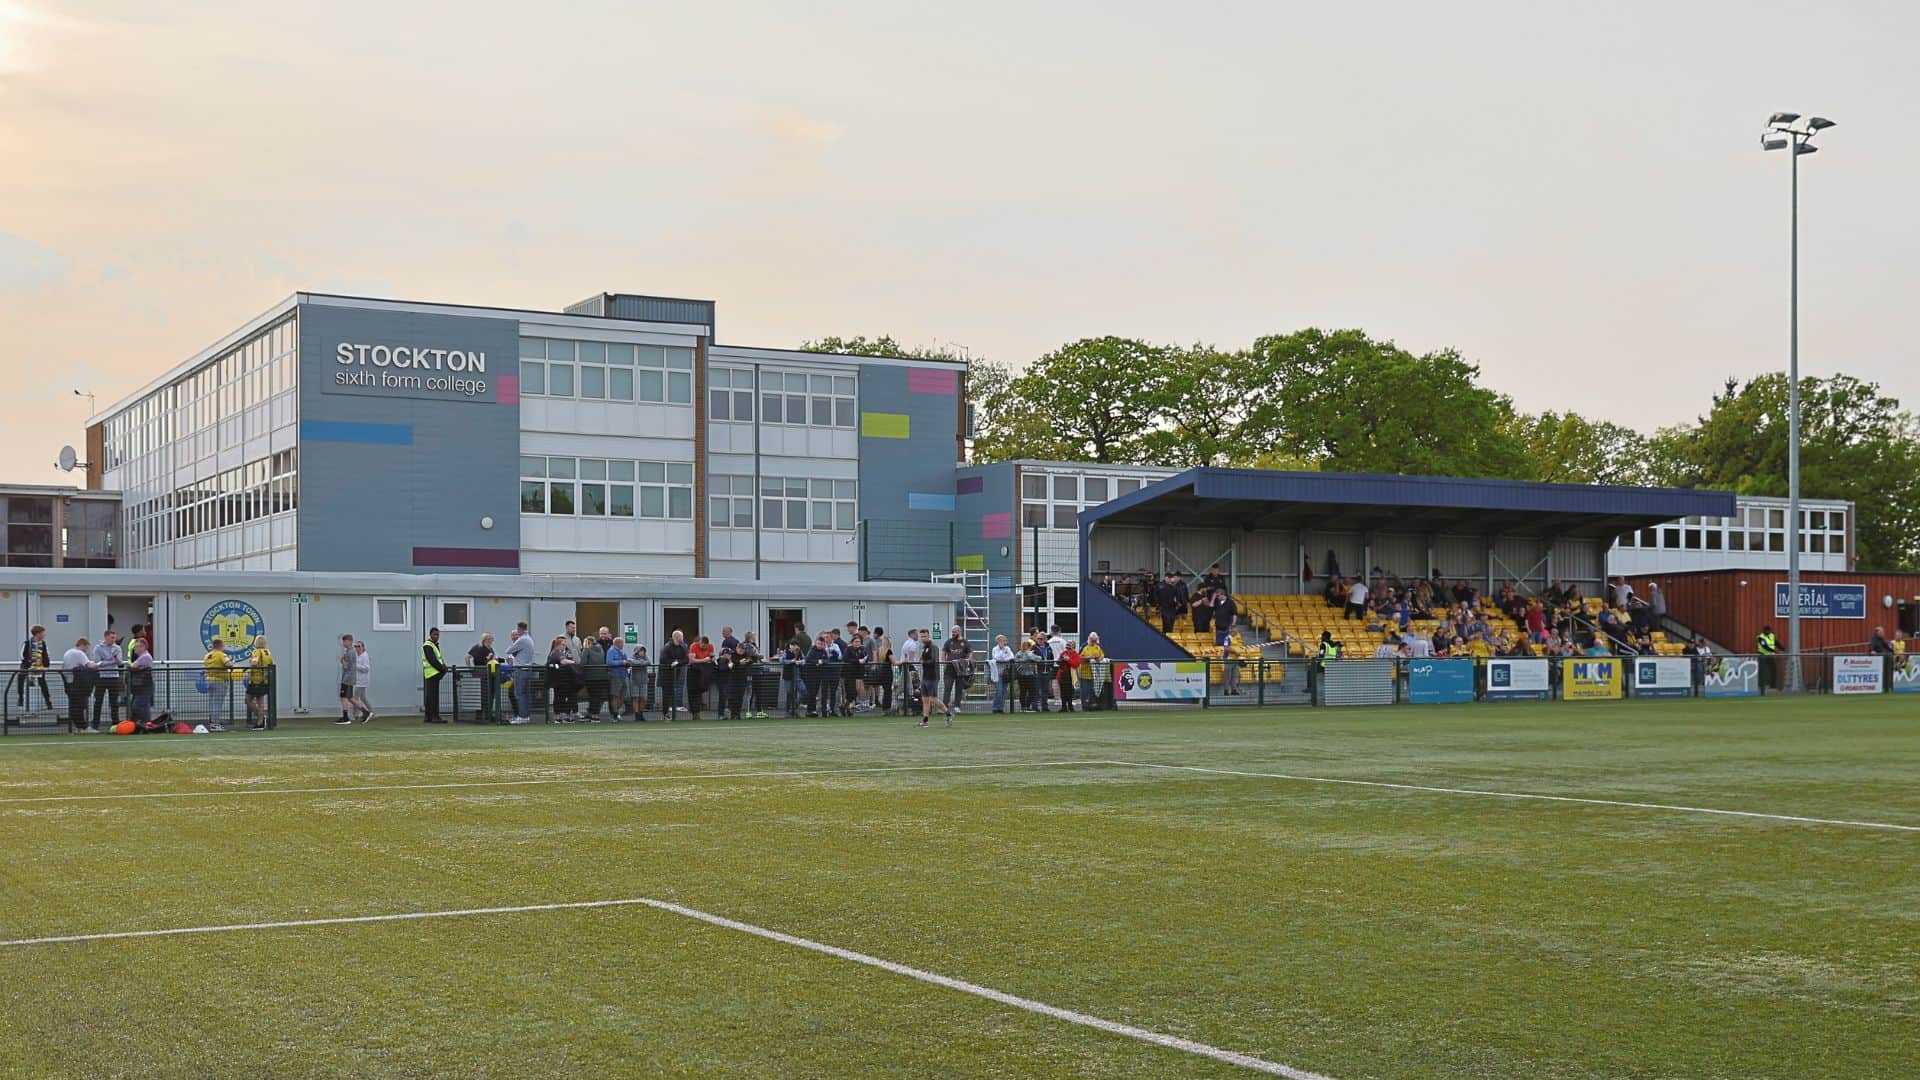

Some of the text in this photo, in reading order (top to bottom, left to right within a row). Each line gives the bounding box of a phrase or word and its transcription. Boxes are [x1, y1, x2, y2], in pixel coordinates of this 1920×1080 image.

[336, 342, 485, 372] STOCKTON
[335, 369, 486, 396] sixth form college
[1778, 589, 1828, 606] IMERIAL
[203, 602, 261, 625] STOCKTON TOWN
[1573, 662, 1612, 686] MKM
[1704, 660, 1758, 692] map
